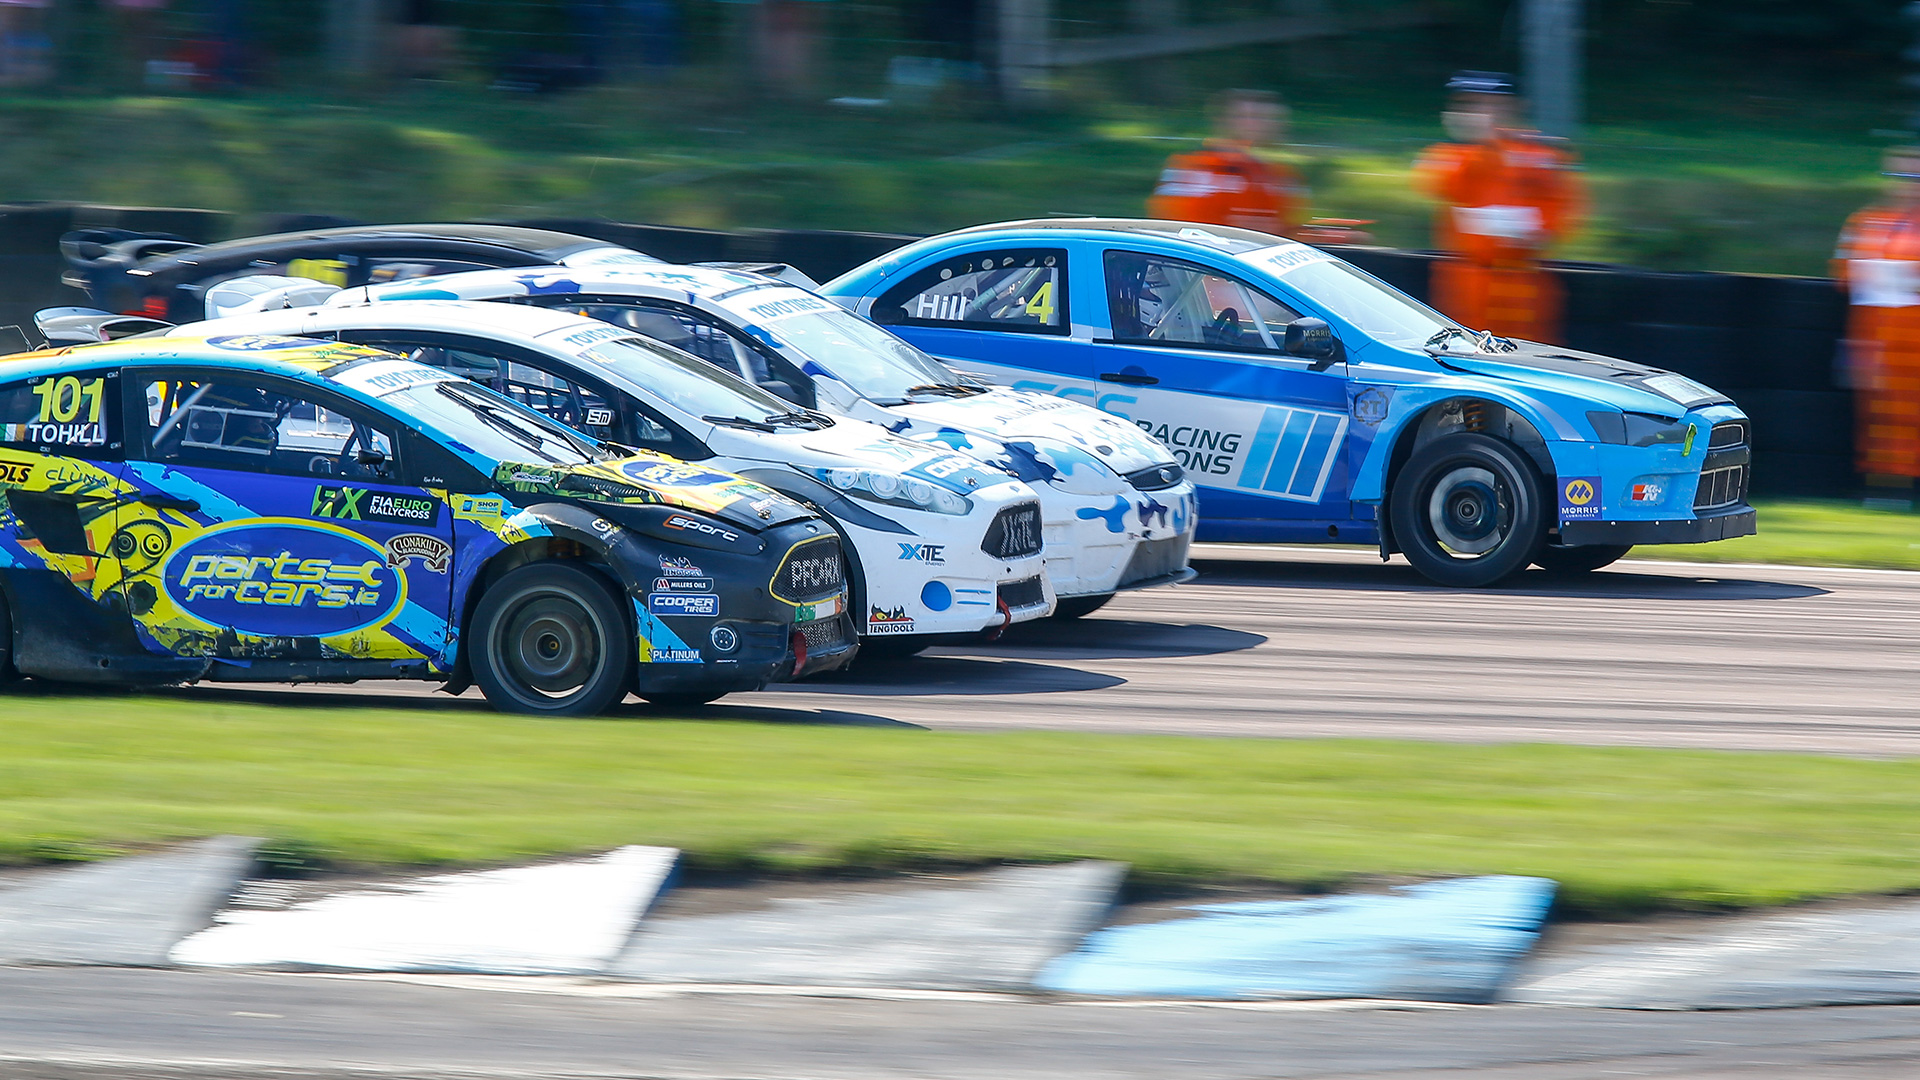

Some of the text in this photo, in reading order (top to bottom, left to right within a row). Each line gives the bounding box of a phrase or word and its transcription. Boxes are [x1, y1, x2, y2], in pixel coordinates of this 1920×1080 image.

[748, 301, 792, 318] TOYO
[916, 282, 1054, 323] Hill 4
[563, 330, 608, 346] TOYO
[365, 372, 414, 389] TOYO
[32, 375, 104, 423] 101
[1360, 400, 1382, 415] RT
[28, 423, 105, 443] TOHILL
[1136, 420, 1242, 454] RACING
[1166, 447, 1234, 475] ONS
[369, 505, 430, 520] RALLYCROSS
[1561, 506, 1599, 515] MORRIS
[393, 537, 447, 558] CLONAKILTY
[179, 551, 333, 588] parts
[654, 597, 714, 607] COOPER
[653, 650, 699, 659] PLATINUM
